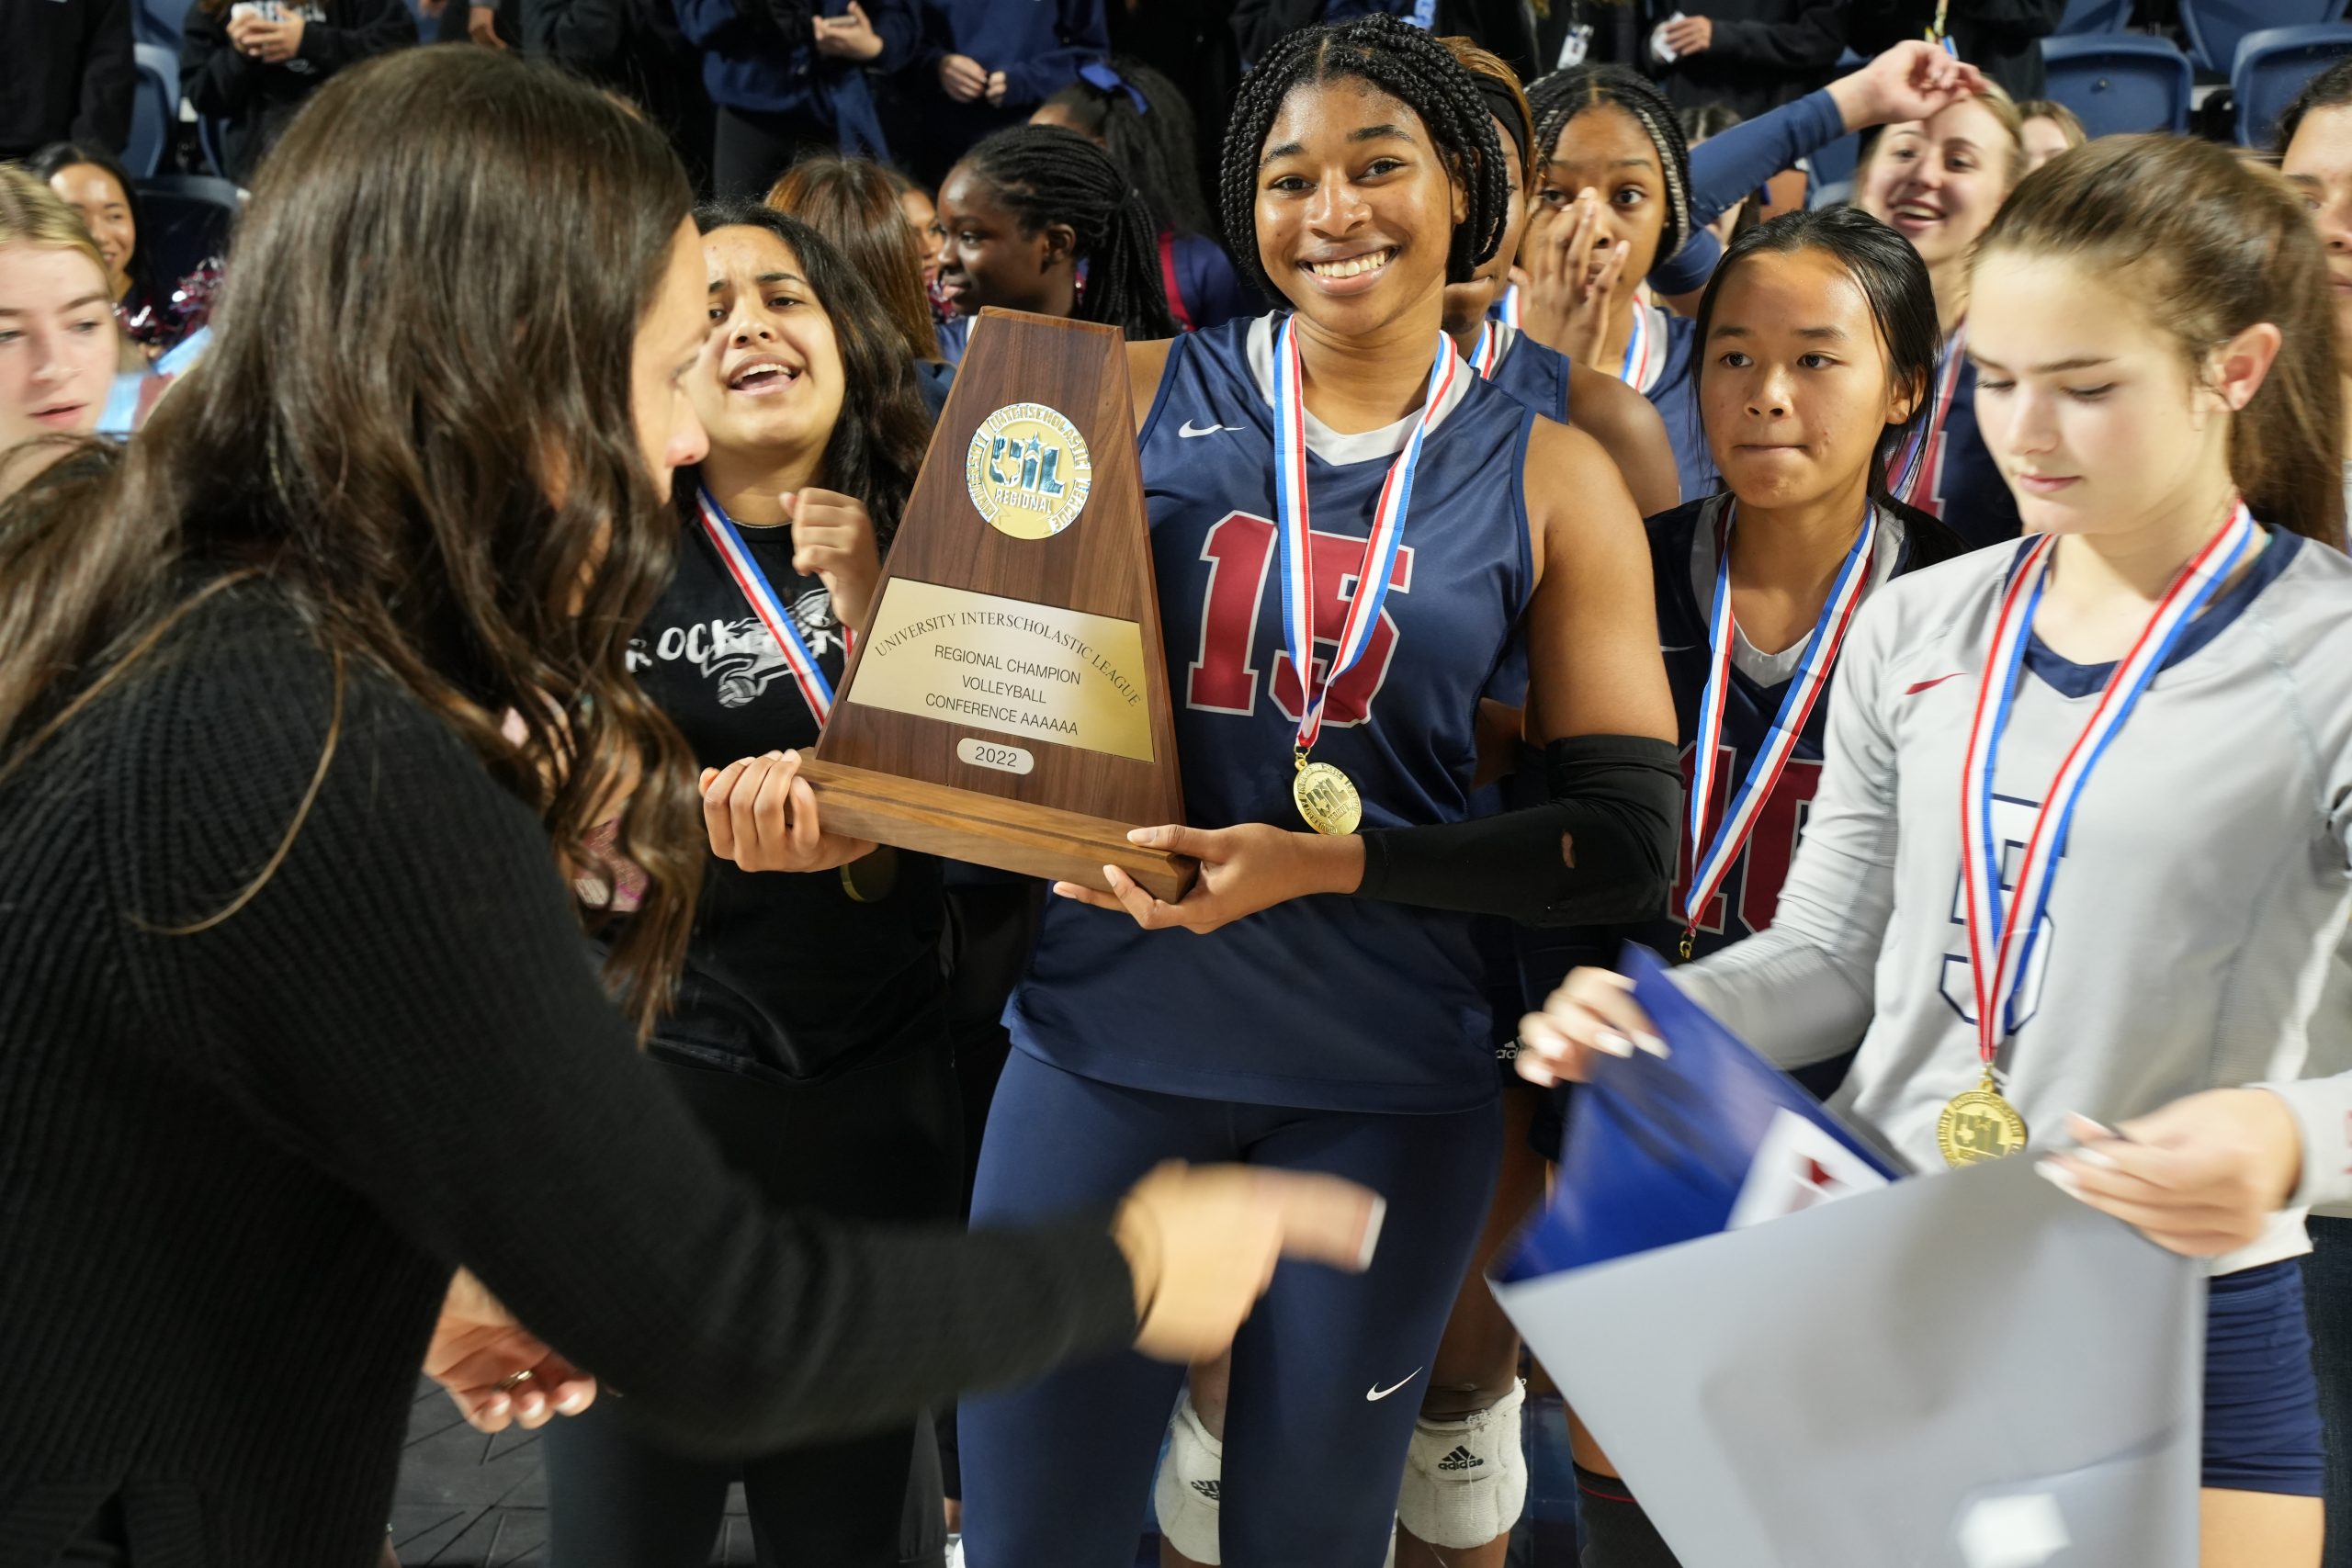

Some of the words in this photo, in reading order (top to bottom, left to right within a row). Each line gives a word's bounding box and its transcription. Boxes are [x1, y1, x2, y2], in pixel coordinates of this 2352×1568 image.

[995, 487, 1052, 514] REGIONAL
[1185, 509, 1415, 728] 15
[875, 613, 956, 658] UNIVERSITY
[962, 611, 1093, 660] INTERSCHOLASTIC
[1091, 654, 1141, 707] LEAGUE
[934, 644, 1002, 671] REGIONAL
[1007, 659, 1081, 685] CHAMPION
[962, 675, 1046, 704] VOLLEYBALL
[925, 693, 1017, 724] CONFERENCE
[1020, 712, 1079, 736] AAAAAA
[975, 746, 1018, 768] 2022
[1438, 1459, 1484, 1471] adidas
